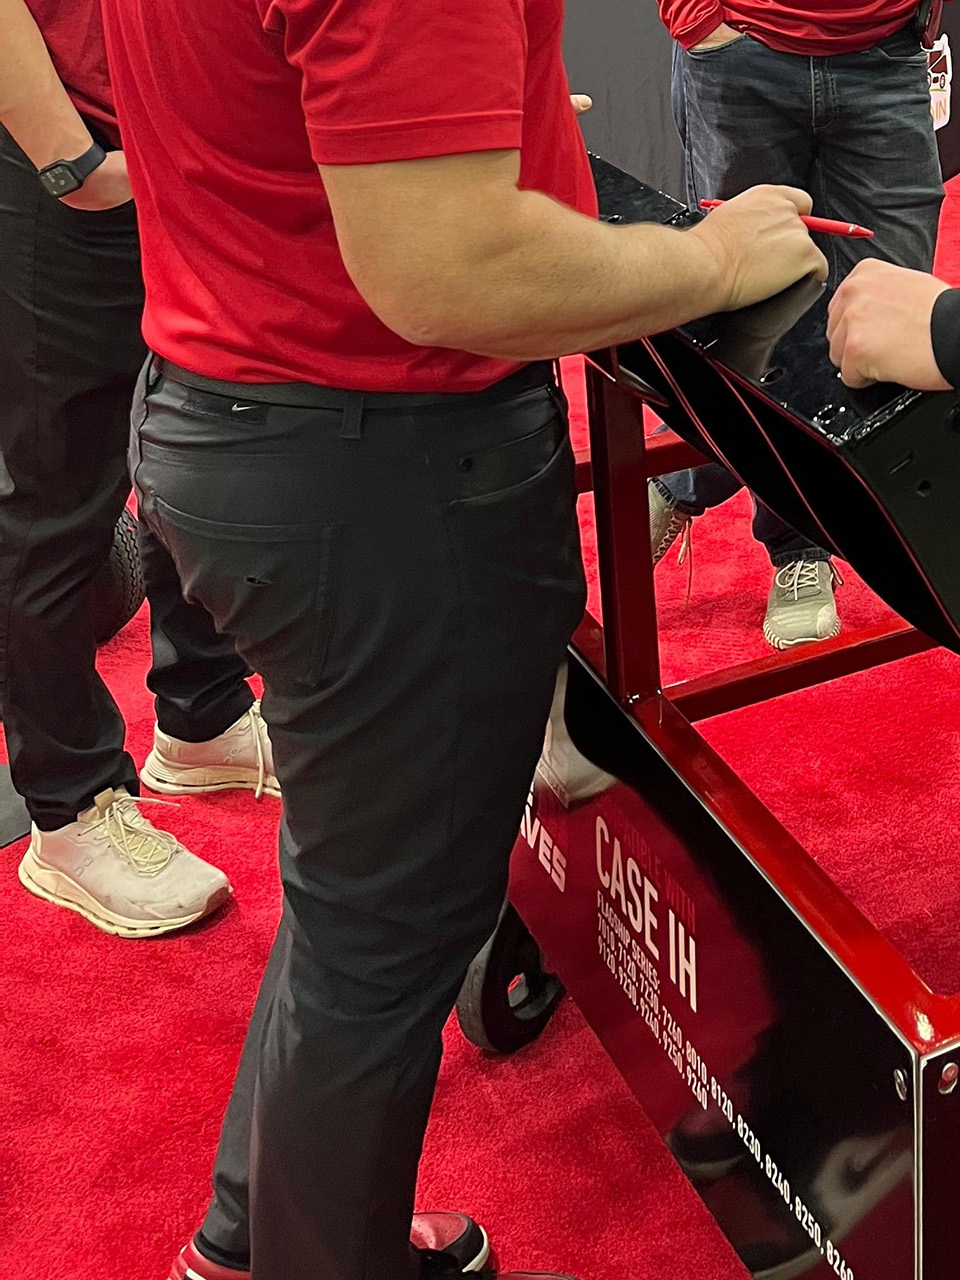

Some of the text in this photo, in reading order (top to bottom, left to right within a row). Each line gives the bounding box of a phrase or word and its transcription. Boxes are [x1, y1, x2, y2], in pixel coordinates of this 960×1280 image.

[595, 815, 697, 1013] CASE IH
[596, 889, 631, 949] FLAGSHIP
